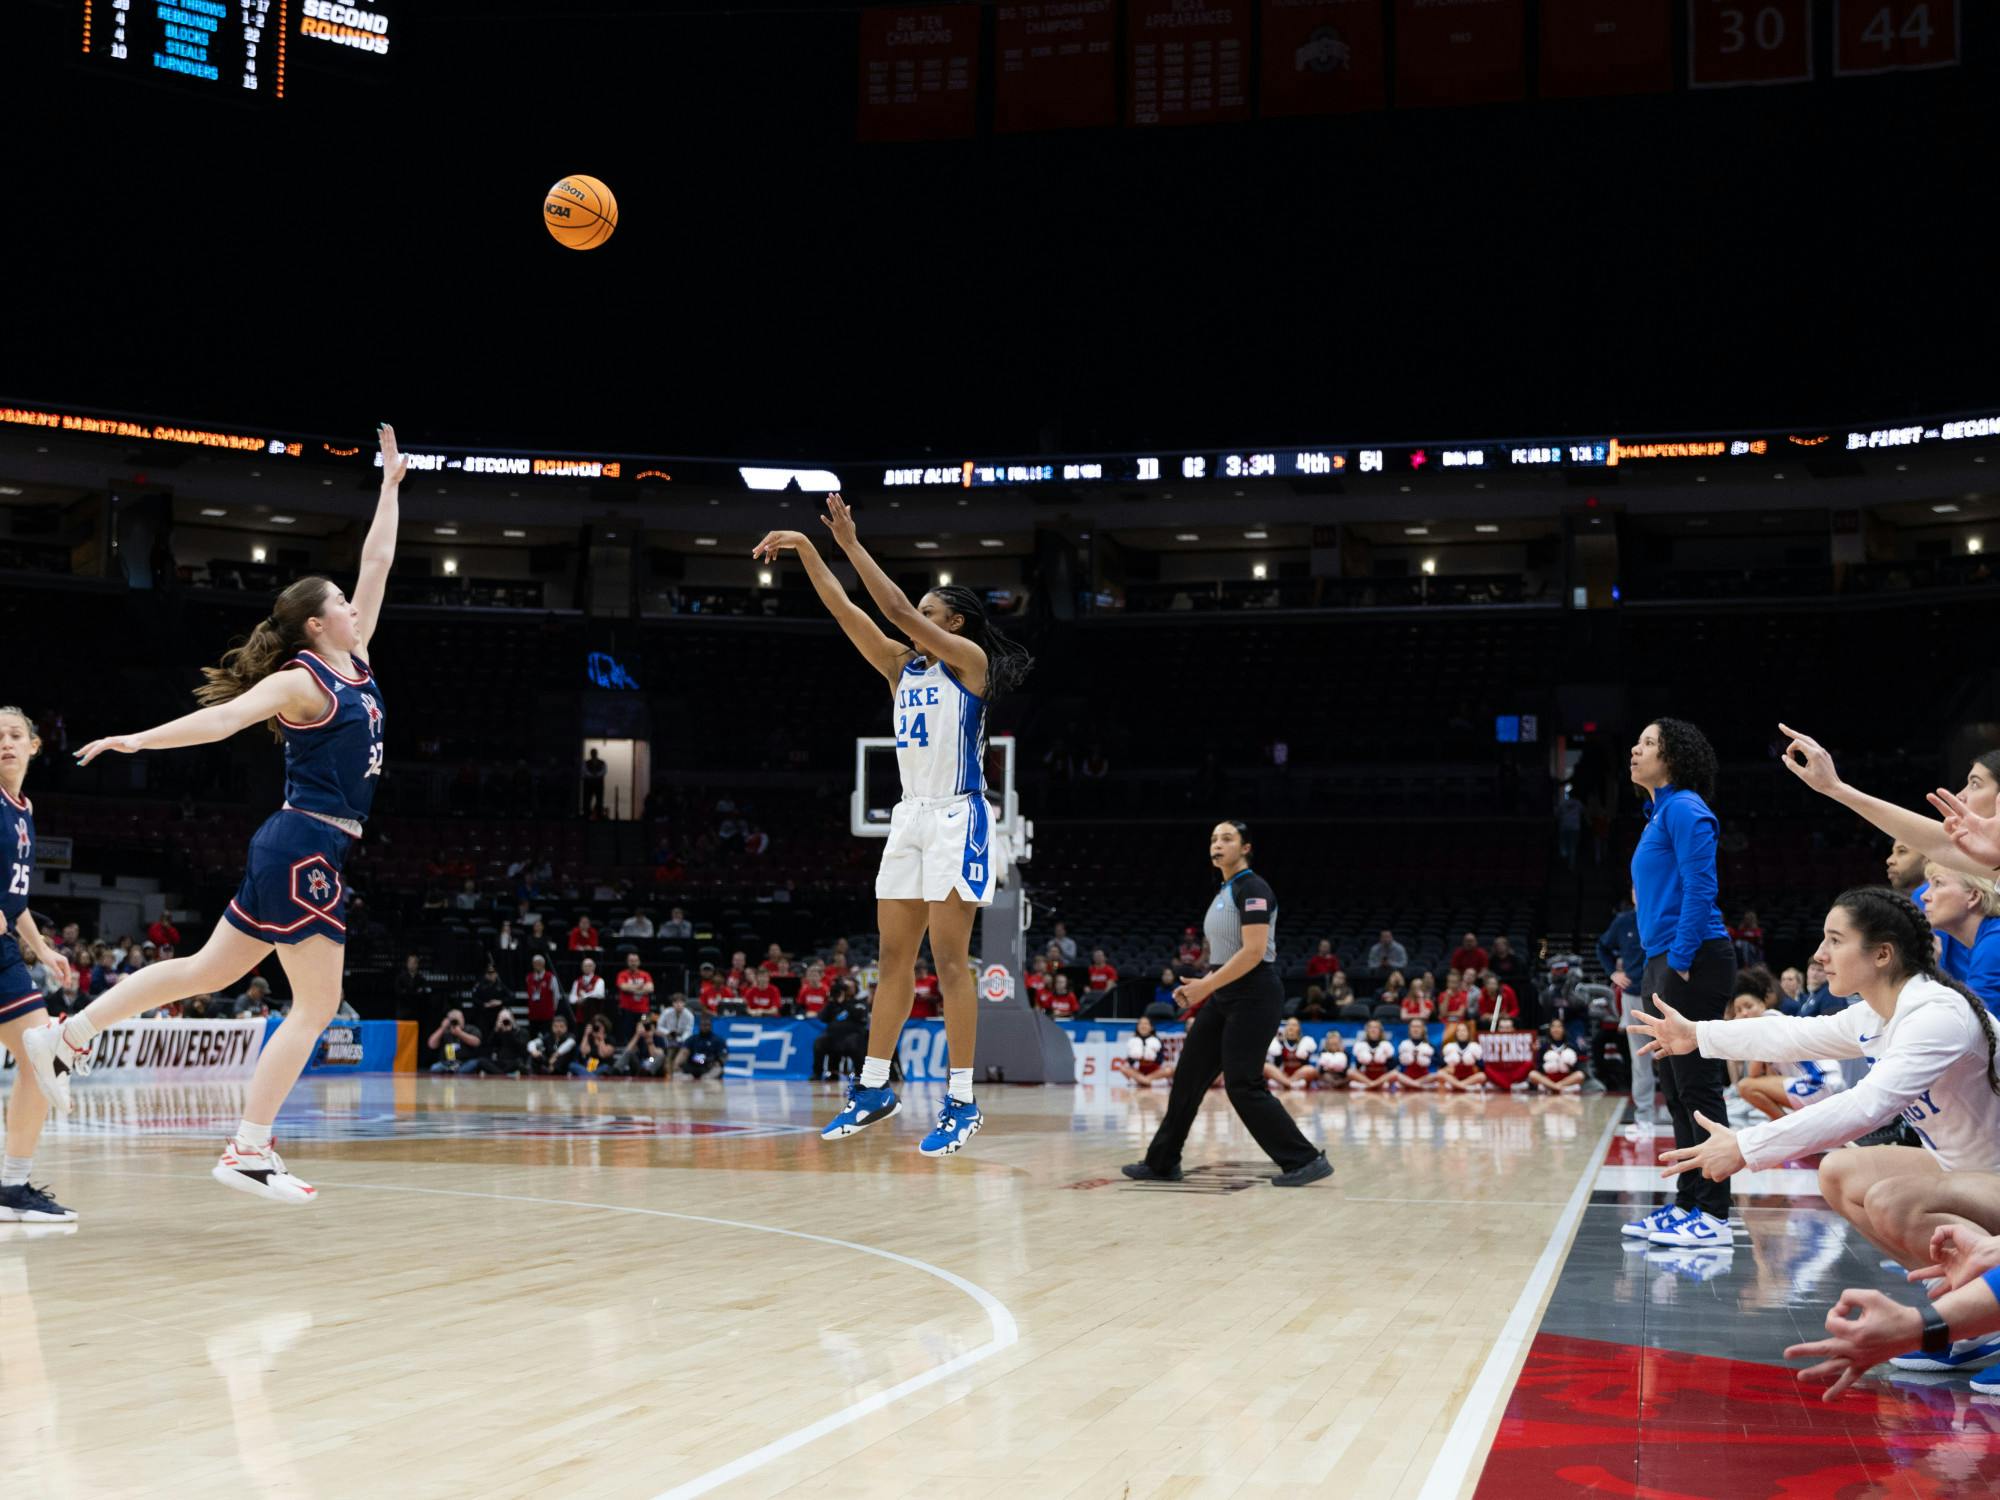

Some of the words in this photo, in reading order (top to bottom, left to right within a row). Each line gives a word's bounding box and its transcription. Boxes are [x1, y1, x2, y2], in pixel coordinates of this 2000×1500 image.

[157, 4, 218, 32] REBOUNDS
[302, 0, 389, 35] SECOND
[1719, 7, 1786, 54] 30
[1861, 3, 1934, 50] 44
[165, 23, 209, 46] BLOCKS
[300, 16, 390, 55] ROUNDS
[110, 42, 128, 60] 10
[165, 39, 207, 62] STEALS
[153, 52, 218, 81] TURNOVERS
[1296, 452, 1330, 474] 4th
[1359, 450, 1382, 472] 54
[8, 862, 31, 896] 25
[968, 862, 984, 882] D
[136, 1029, 255, 1068] UNIVERSITY
[1478, 1032, 1533, 1063] DEFENSE
